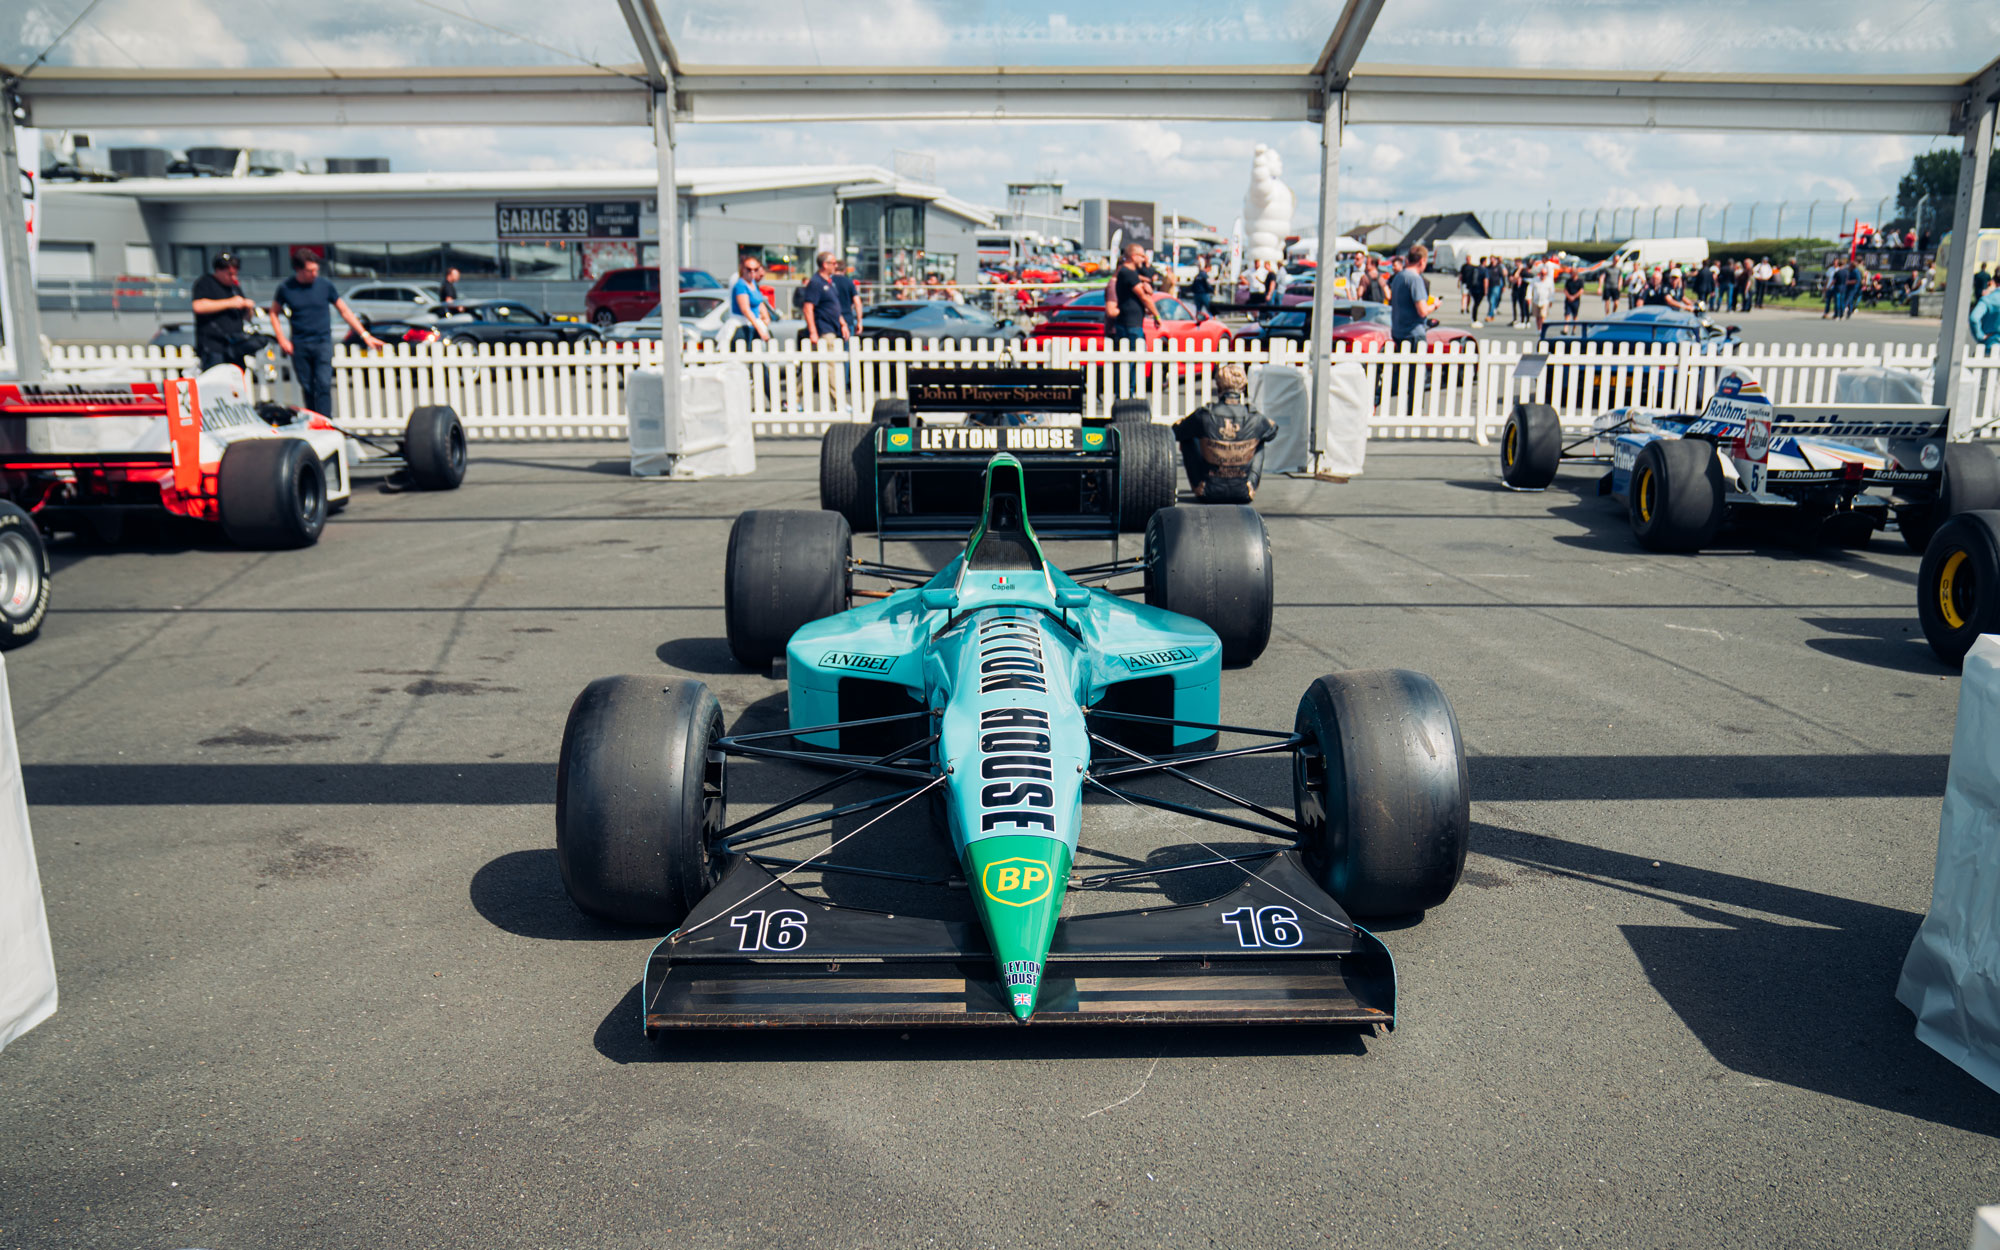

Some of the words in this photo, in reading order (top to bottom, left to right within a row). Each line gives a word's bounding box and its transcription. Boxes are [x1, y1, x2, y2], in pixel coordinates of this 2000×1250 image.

[500, 209, 562, 231] GARAGE
[568, 209, 588, 231] 39
[918, 386, 957, 400] John
[961, 387, 1011, 401] Player
[1013, 387, 1072, 401] Special
[1708, 400, 1747, 420] Rothma
[1771, 413, 1931, 436] Rothmans
[921, 429, 998, 448] LEYTON
[1006, 429, 1074, 448] HOUSE
[1751, 464, 1760, 492] 5
[1777, 470, 1833, 479] Rothmans
[1873, 470, 1928, 481] Rothmans
[824, 653, 890, 670] ANIBEL
[979, 615, 1048, 695] LEYTON
[1128, 649, 1192, 667] ANIBEL
[979, 708, 1056, 833] HOUSE
[997, 866, 1045, 892] BP
[730, 909, 808, 951] 16
[1221, 905, 1303, 947] 16
[1003, 960, 1041, 976] LEYTON
[1005, 973, 1037, 988] HOUSE
